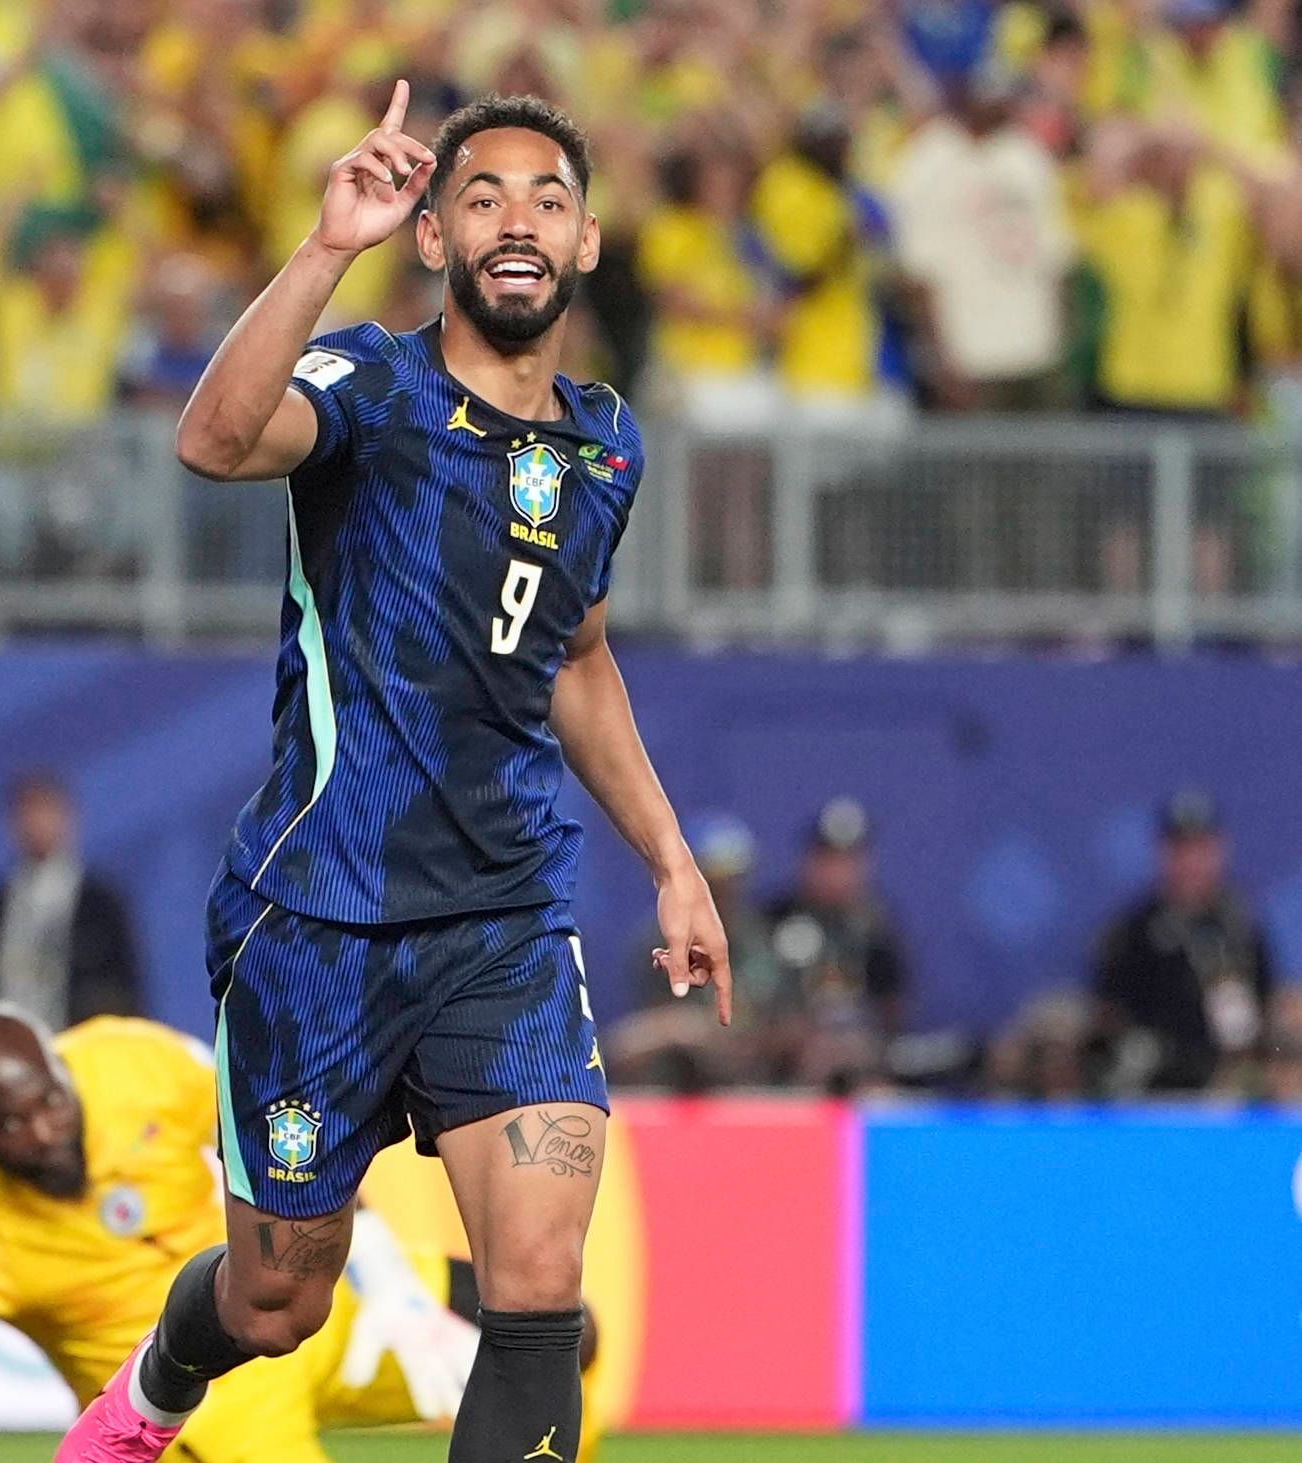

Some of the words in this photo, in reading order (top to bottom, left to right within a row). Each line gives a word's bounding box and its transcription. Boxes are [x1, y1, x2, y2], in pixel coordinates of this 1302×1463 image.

[526, 476, 545, 487] CBF
[510, 522, 559, 550] BRASIL
[490, 559, 543, 655] 9
[267, 1166, 317, 1183] BRASIL
